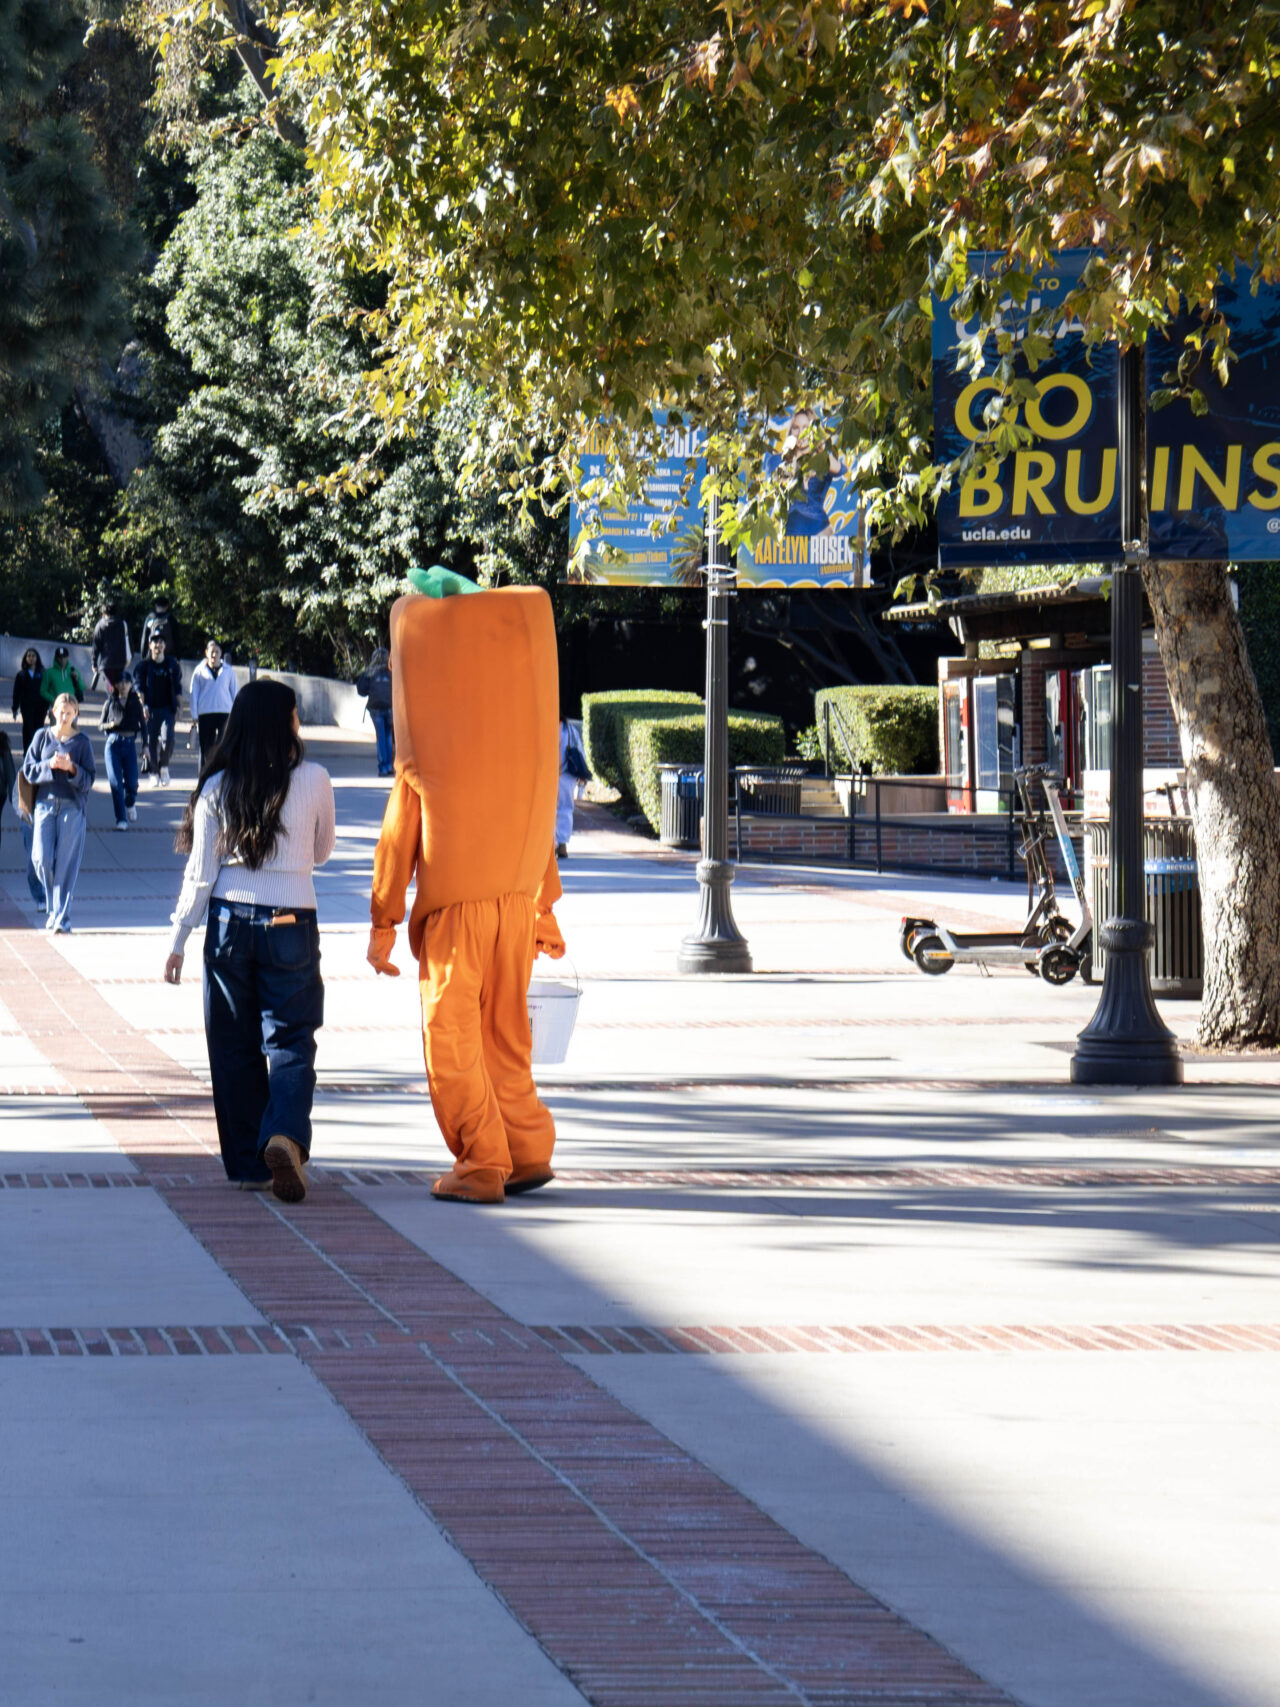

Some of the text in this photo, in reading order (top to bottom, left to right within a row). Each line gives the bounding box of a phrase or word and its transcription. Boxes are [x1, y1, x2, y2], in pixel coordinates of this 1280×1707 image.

[1039, 277, 1060, 291] TO
[959, 448, 1118, 518] BRU
[962, 526, 1031, 541] ucla.edu
[810, 535, 854, 565] ROSEN
